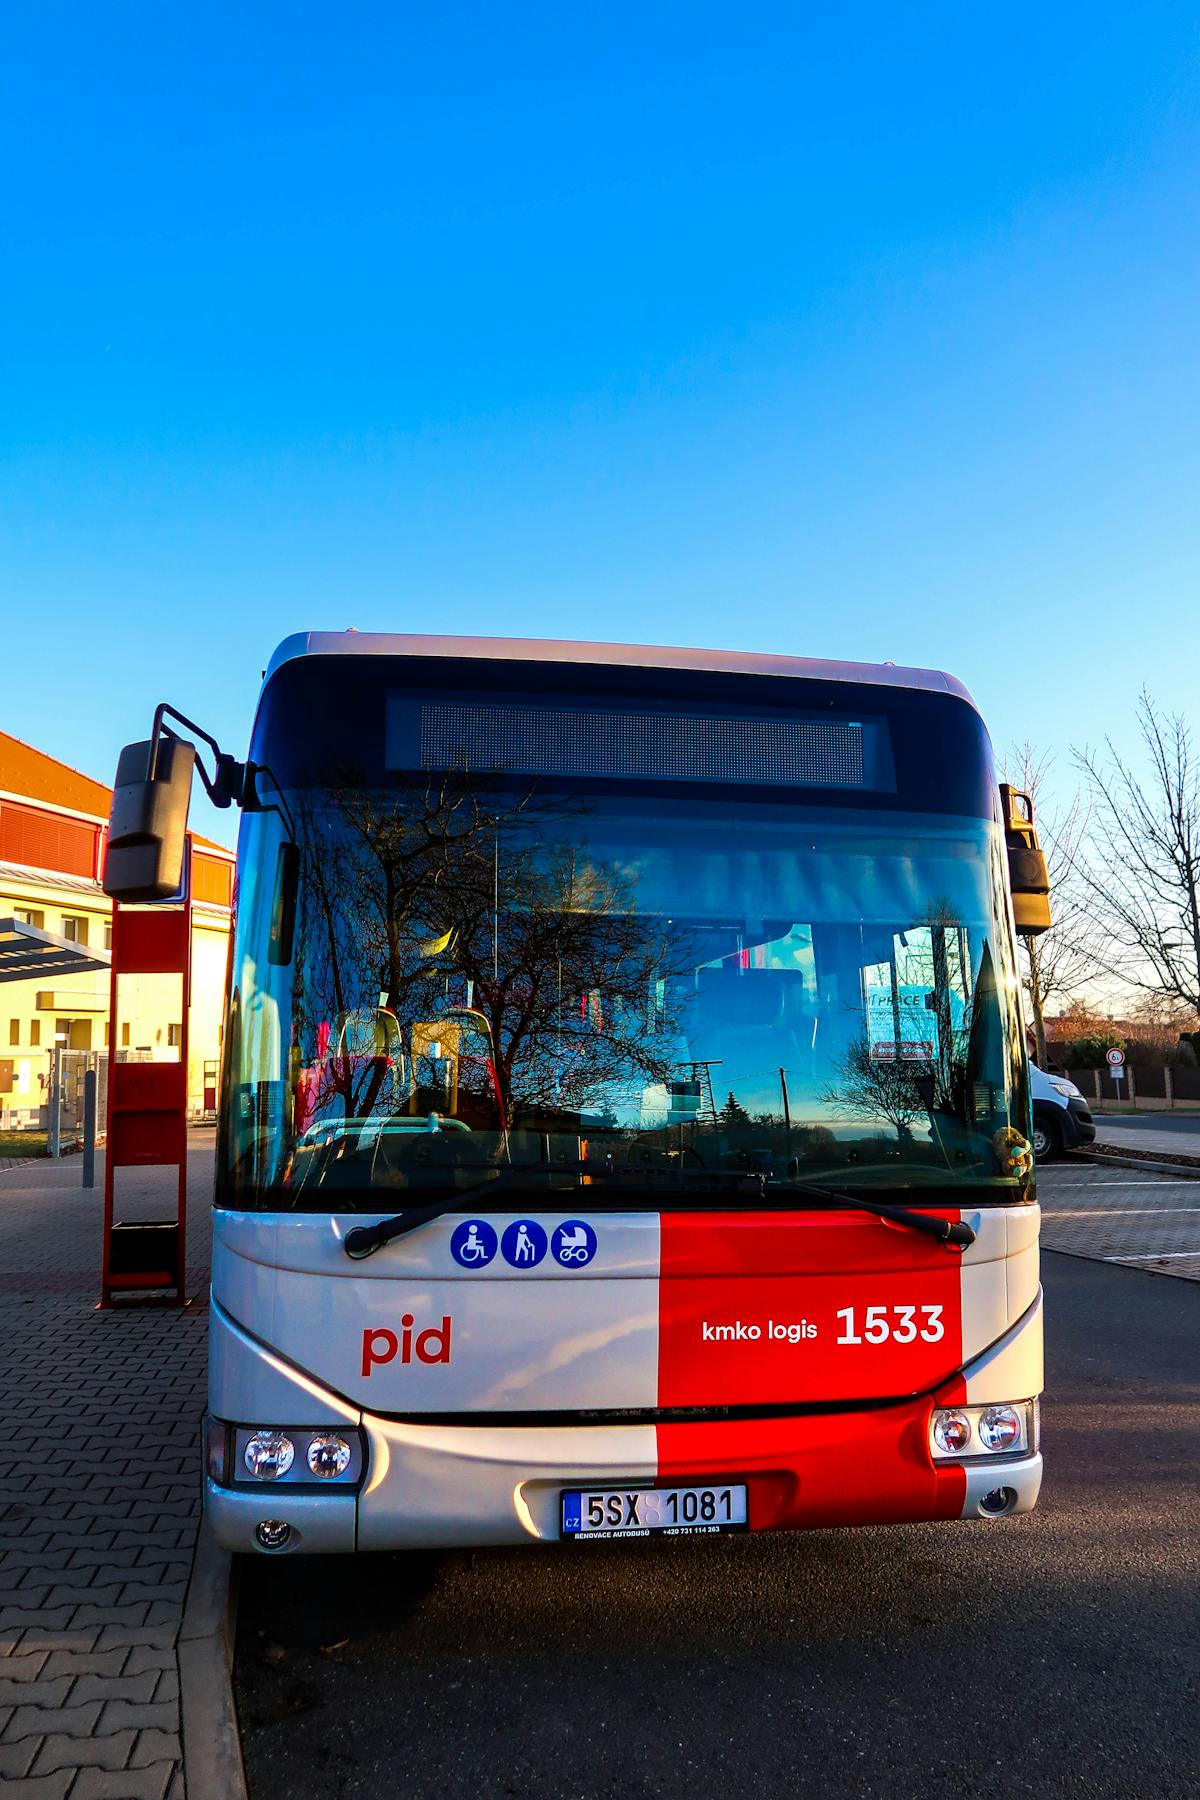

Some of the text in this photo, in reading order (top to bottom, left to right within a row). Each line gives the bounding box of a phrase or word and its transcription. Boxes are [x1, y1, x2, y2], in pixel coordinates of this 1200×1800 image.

[878, 994, 919, 1006] PRCE
[702, 1319, 818, 1344] kmko logis
[836, 1305, 945, 1345] 1533
[361, 1313, 452, 1377] pid
[588, 1489, 732, 1526] 5SX 1081
[565, 1518, 580, 1528] CZ
[574, 1532, 611, 1540] RENOVACE
